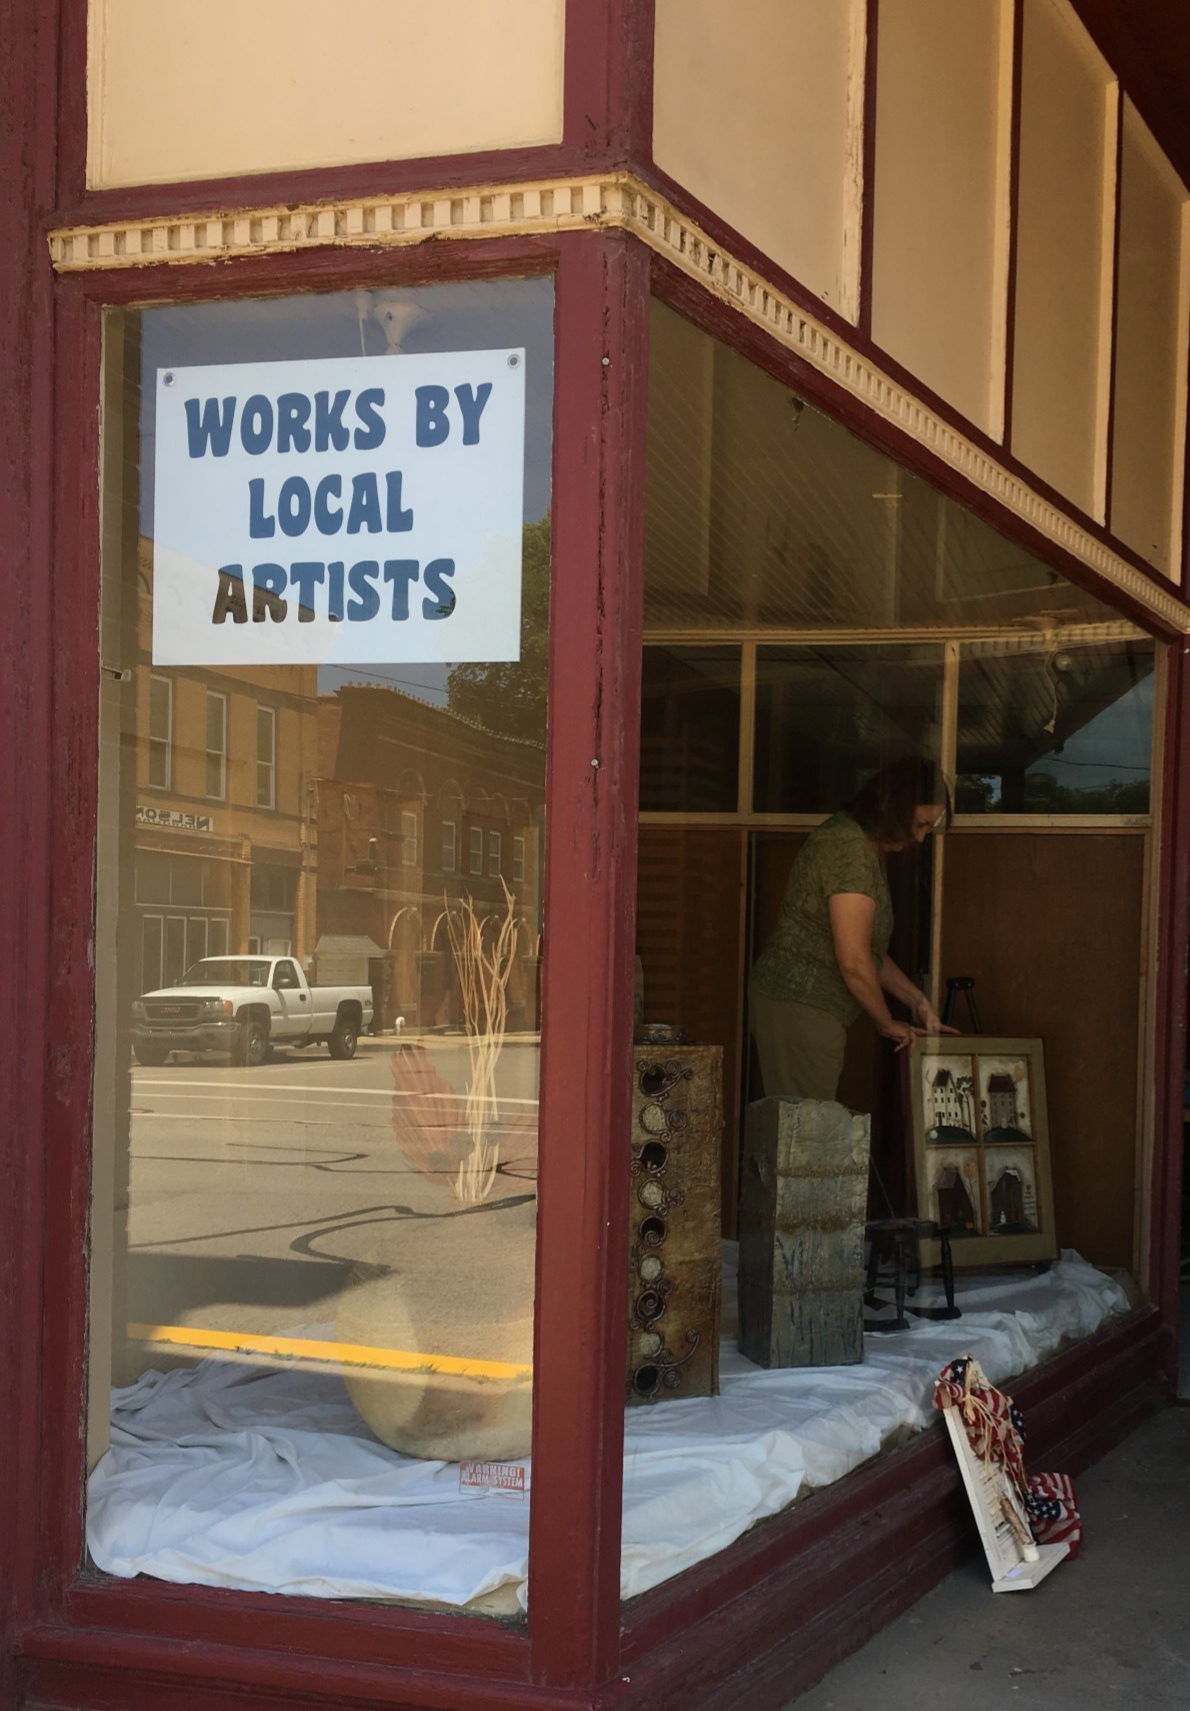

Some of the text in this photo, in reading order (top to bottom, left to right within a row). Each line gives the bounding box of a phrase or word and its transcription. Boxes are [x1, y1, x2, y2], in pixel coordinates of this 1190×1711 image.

[184, 382, 493, 459] WORKS BY
[248, 470, 414, 539] LOCAL
[211, 558, 457, 625] ARTISTS
[465, 1462, 521, 1477] WARNING!
[494, 1475, 523, 1488] SYSTEM
